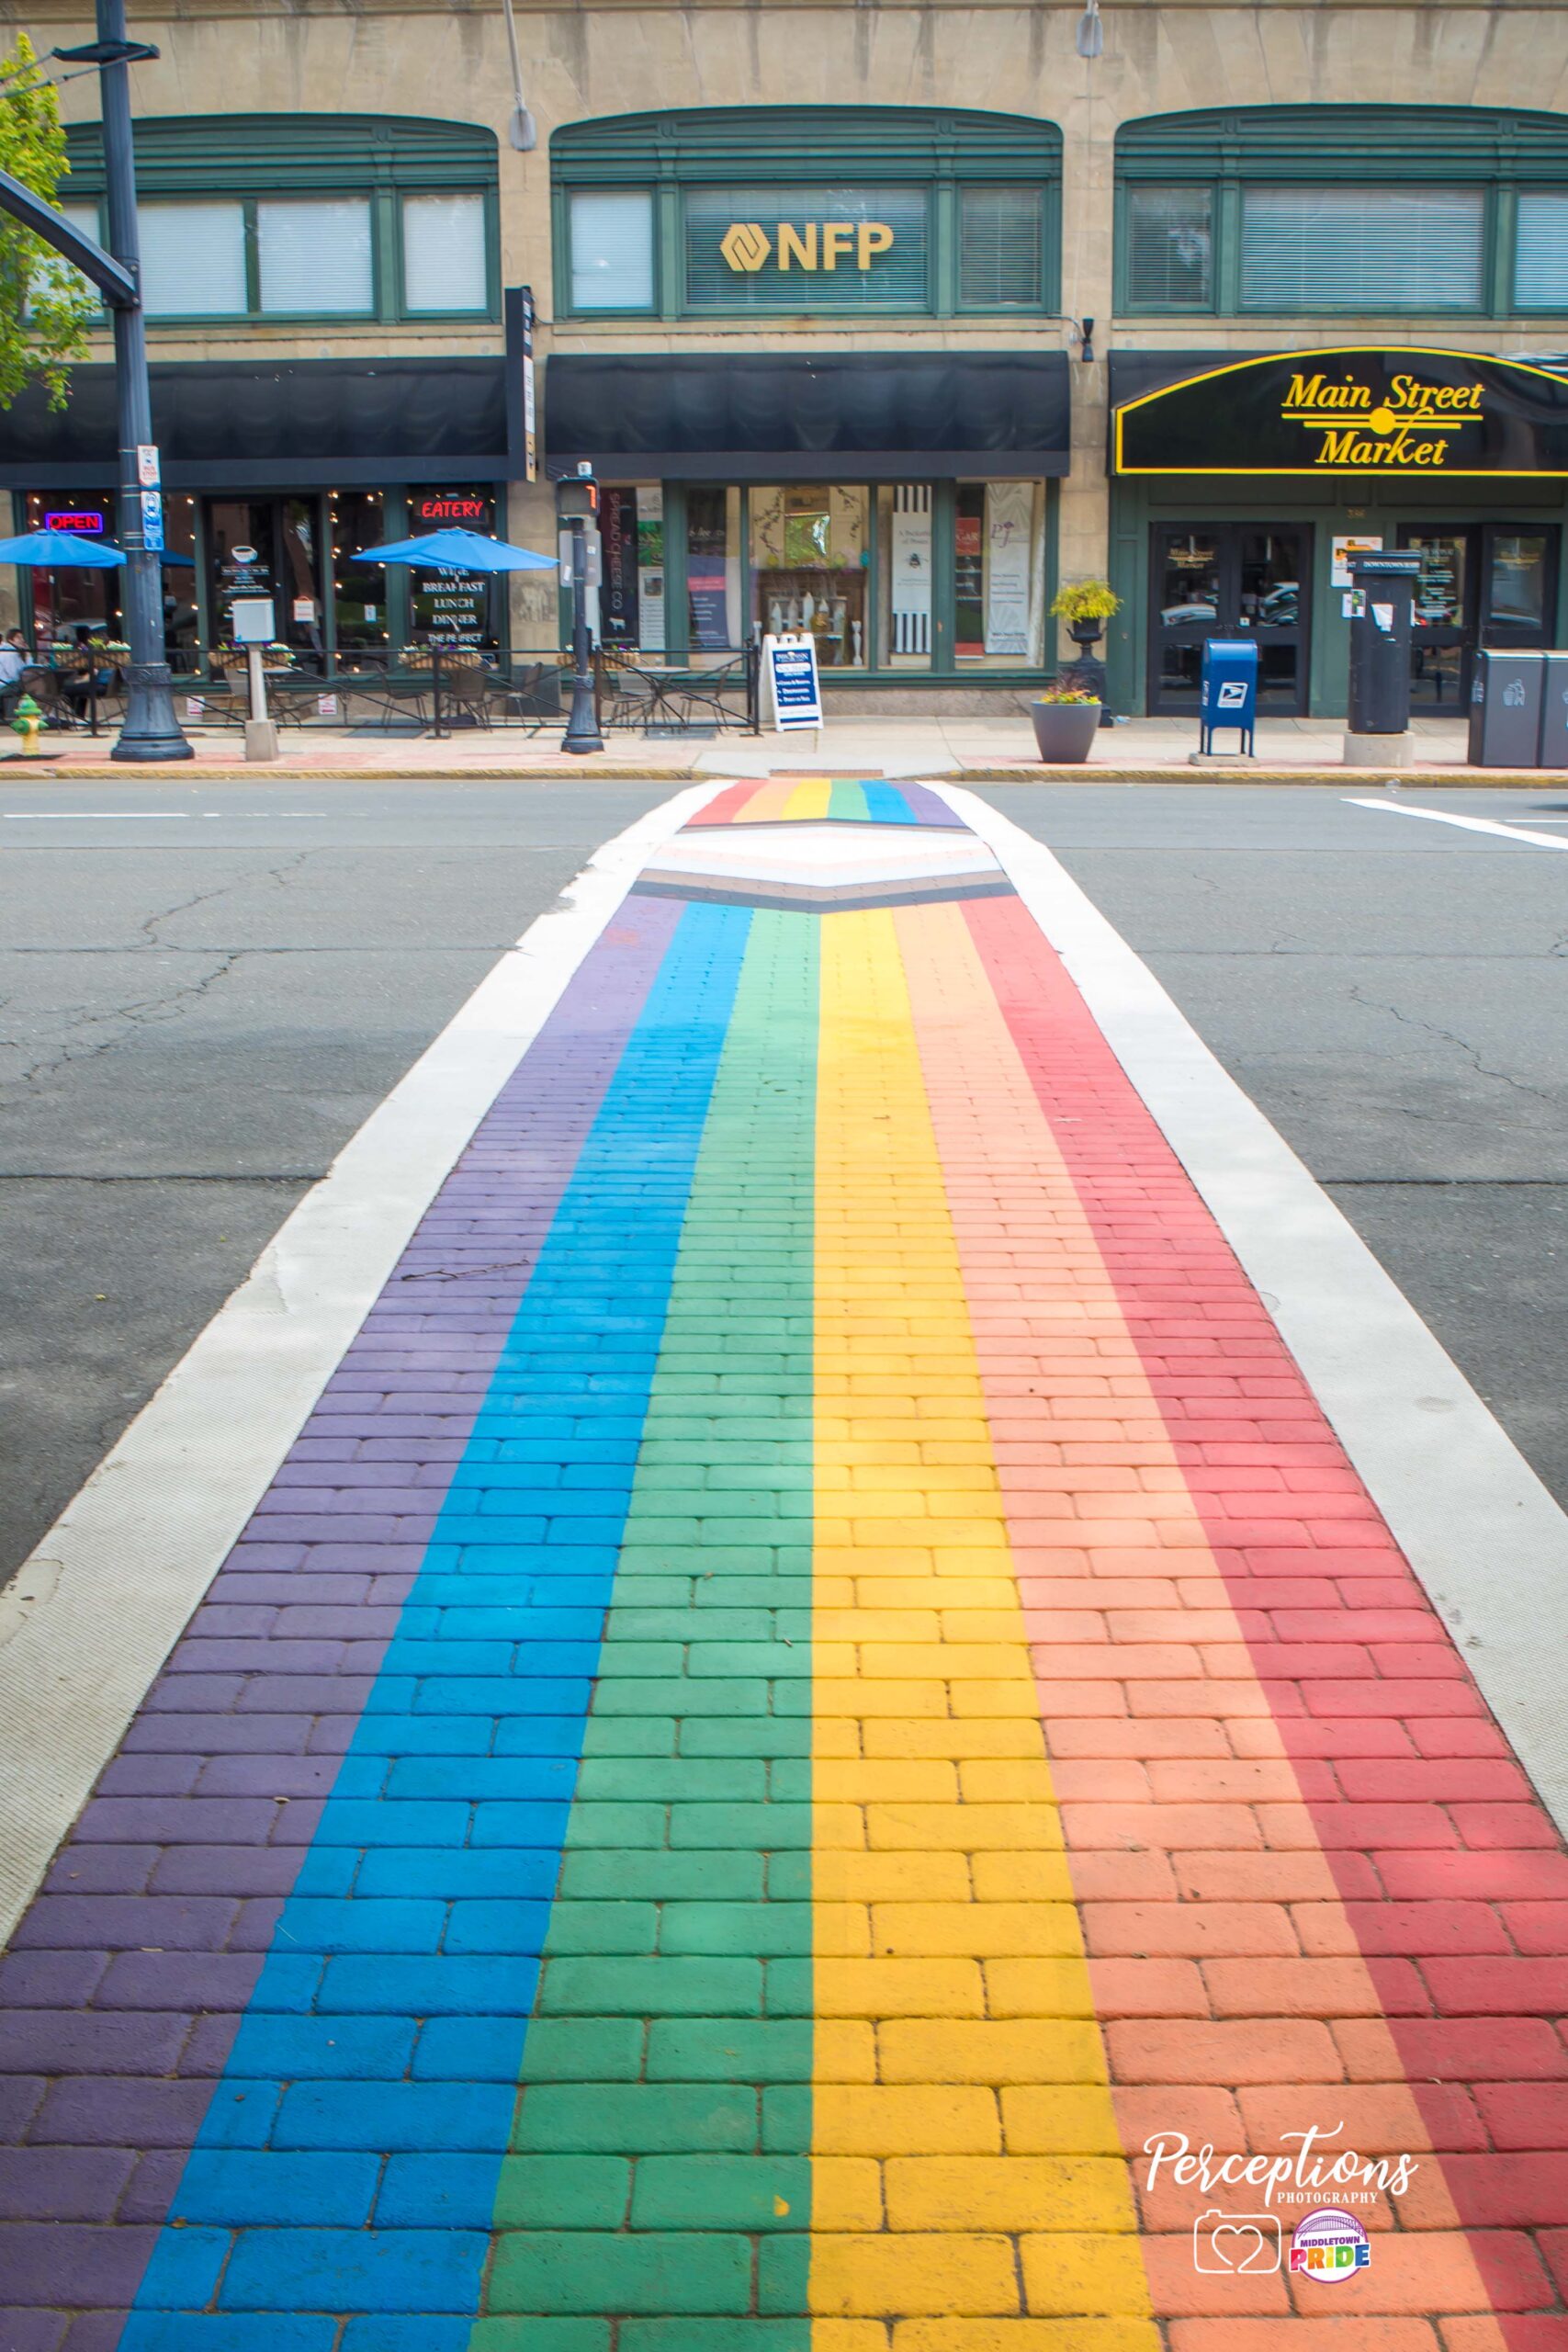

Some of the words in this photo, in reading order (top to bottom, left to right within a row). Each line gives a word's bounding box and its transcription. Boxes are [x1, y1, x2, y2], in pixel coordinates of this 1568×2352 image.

[778, 223, 895, 271] NFP
[1280, 374, 1372, 407] Main
[1382, 375, 1485, 409] Street
[1314, 406, 1449, 465] Market
[49, 515, 99, 529] OPEN
[422, 501, 483, 518] EATERY
[609, 492, 622, 541] SPREAD
[605, 543, 623, 590] CHEESE
[432, 615, 478, 625] DINNER
[434, 598, 475, 608] LUNCH
